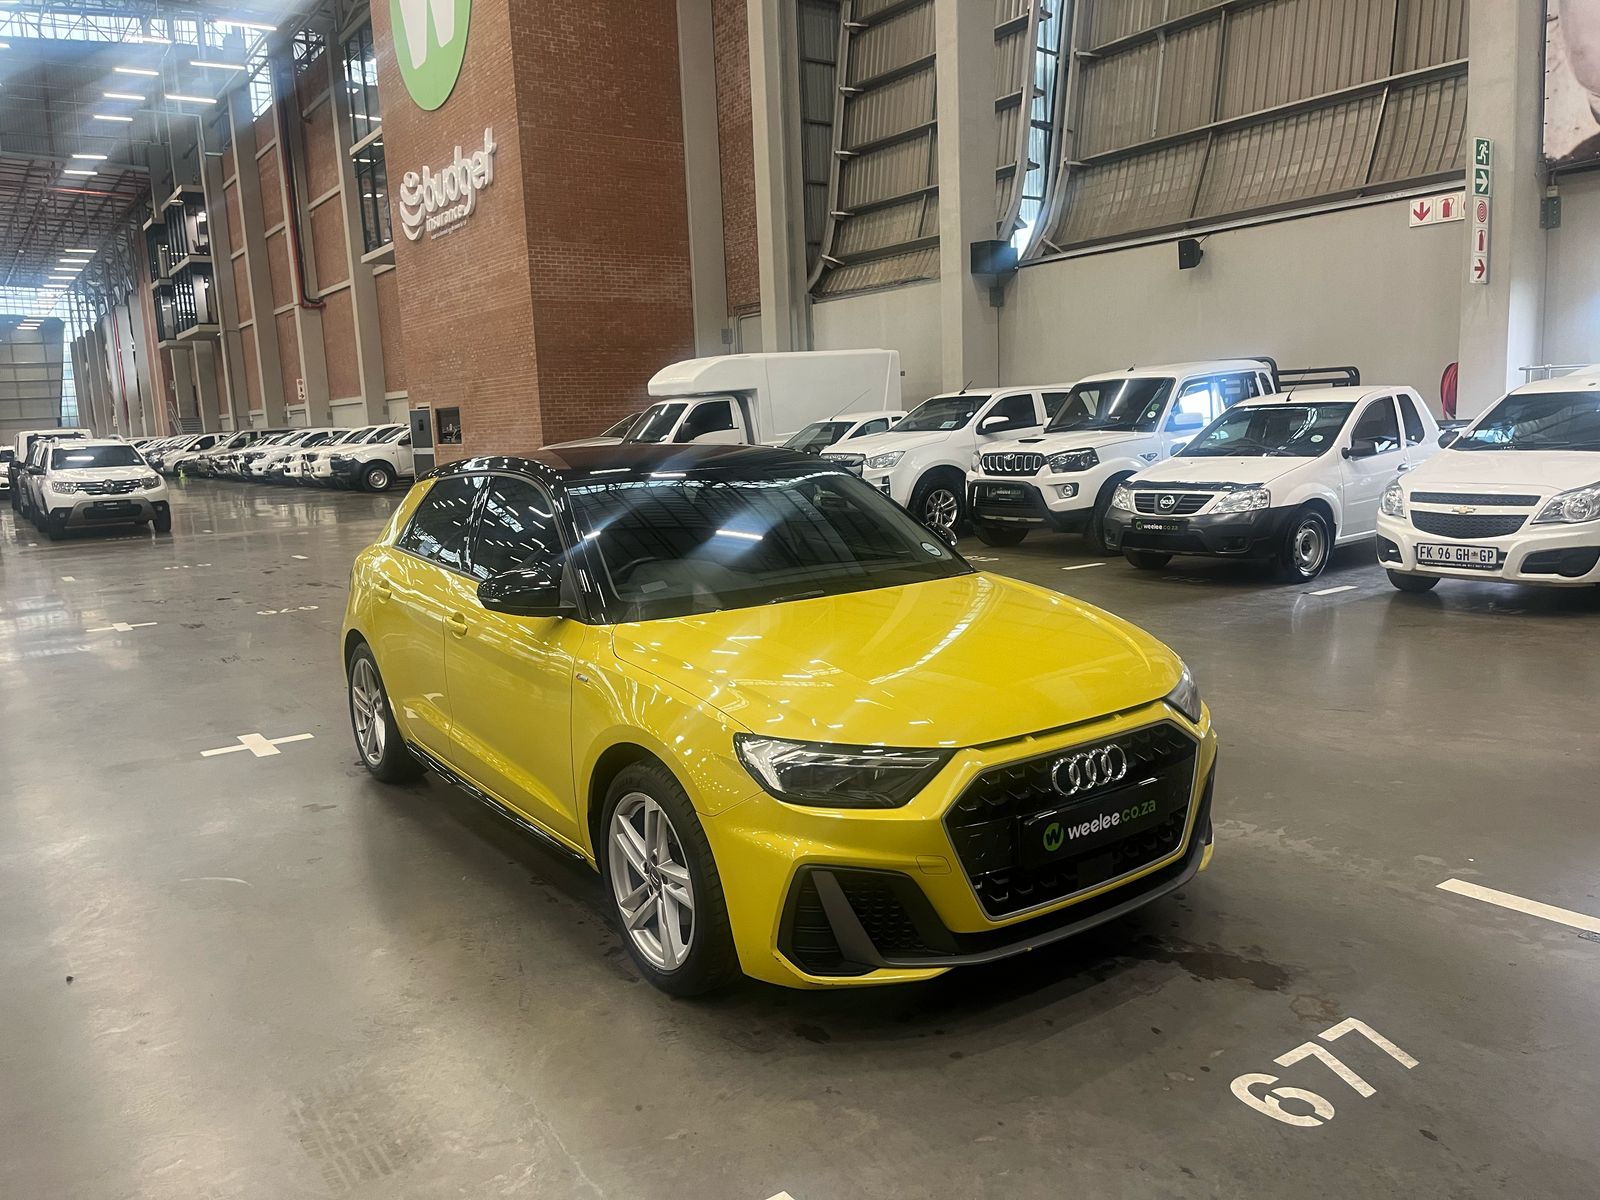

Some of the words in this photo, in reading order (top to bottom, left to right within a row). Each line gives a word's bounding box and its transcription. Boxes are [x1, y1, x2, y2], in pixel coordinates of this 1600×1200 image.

[422, 128, 497, 217] budget
[1420, 546, 1433, 558] FK
[1438, 547, 1451, 560] 96
[1456, 548, 1470, 561] GH
[1480, 549, 1494, 562] GP
[1068, 799, 1157, 840] weelee.co.za
[1230, 1017, 1420, 1127] 677
